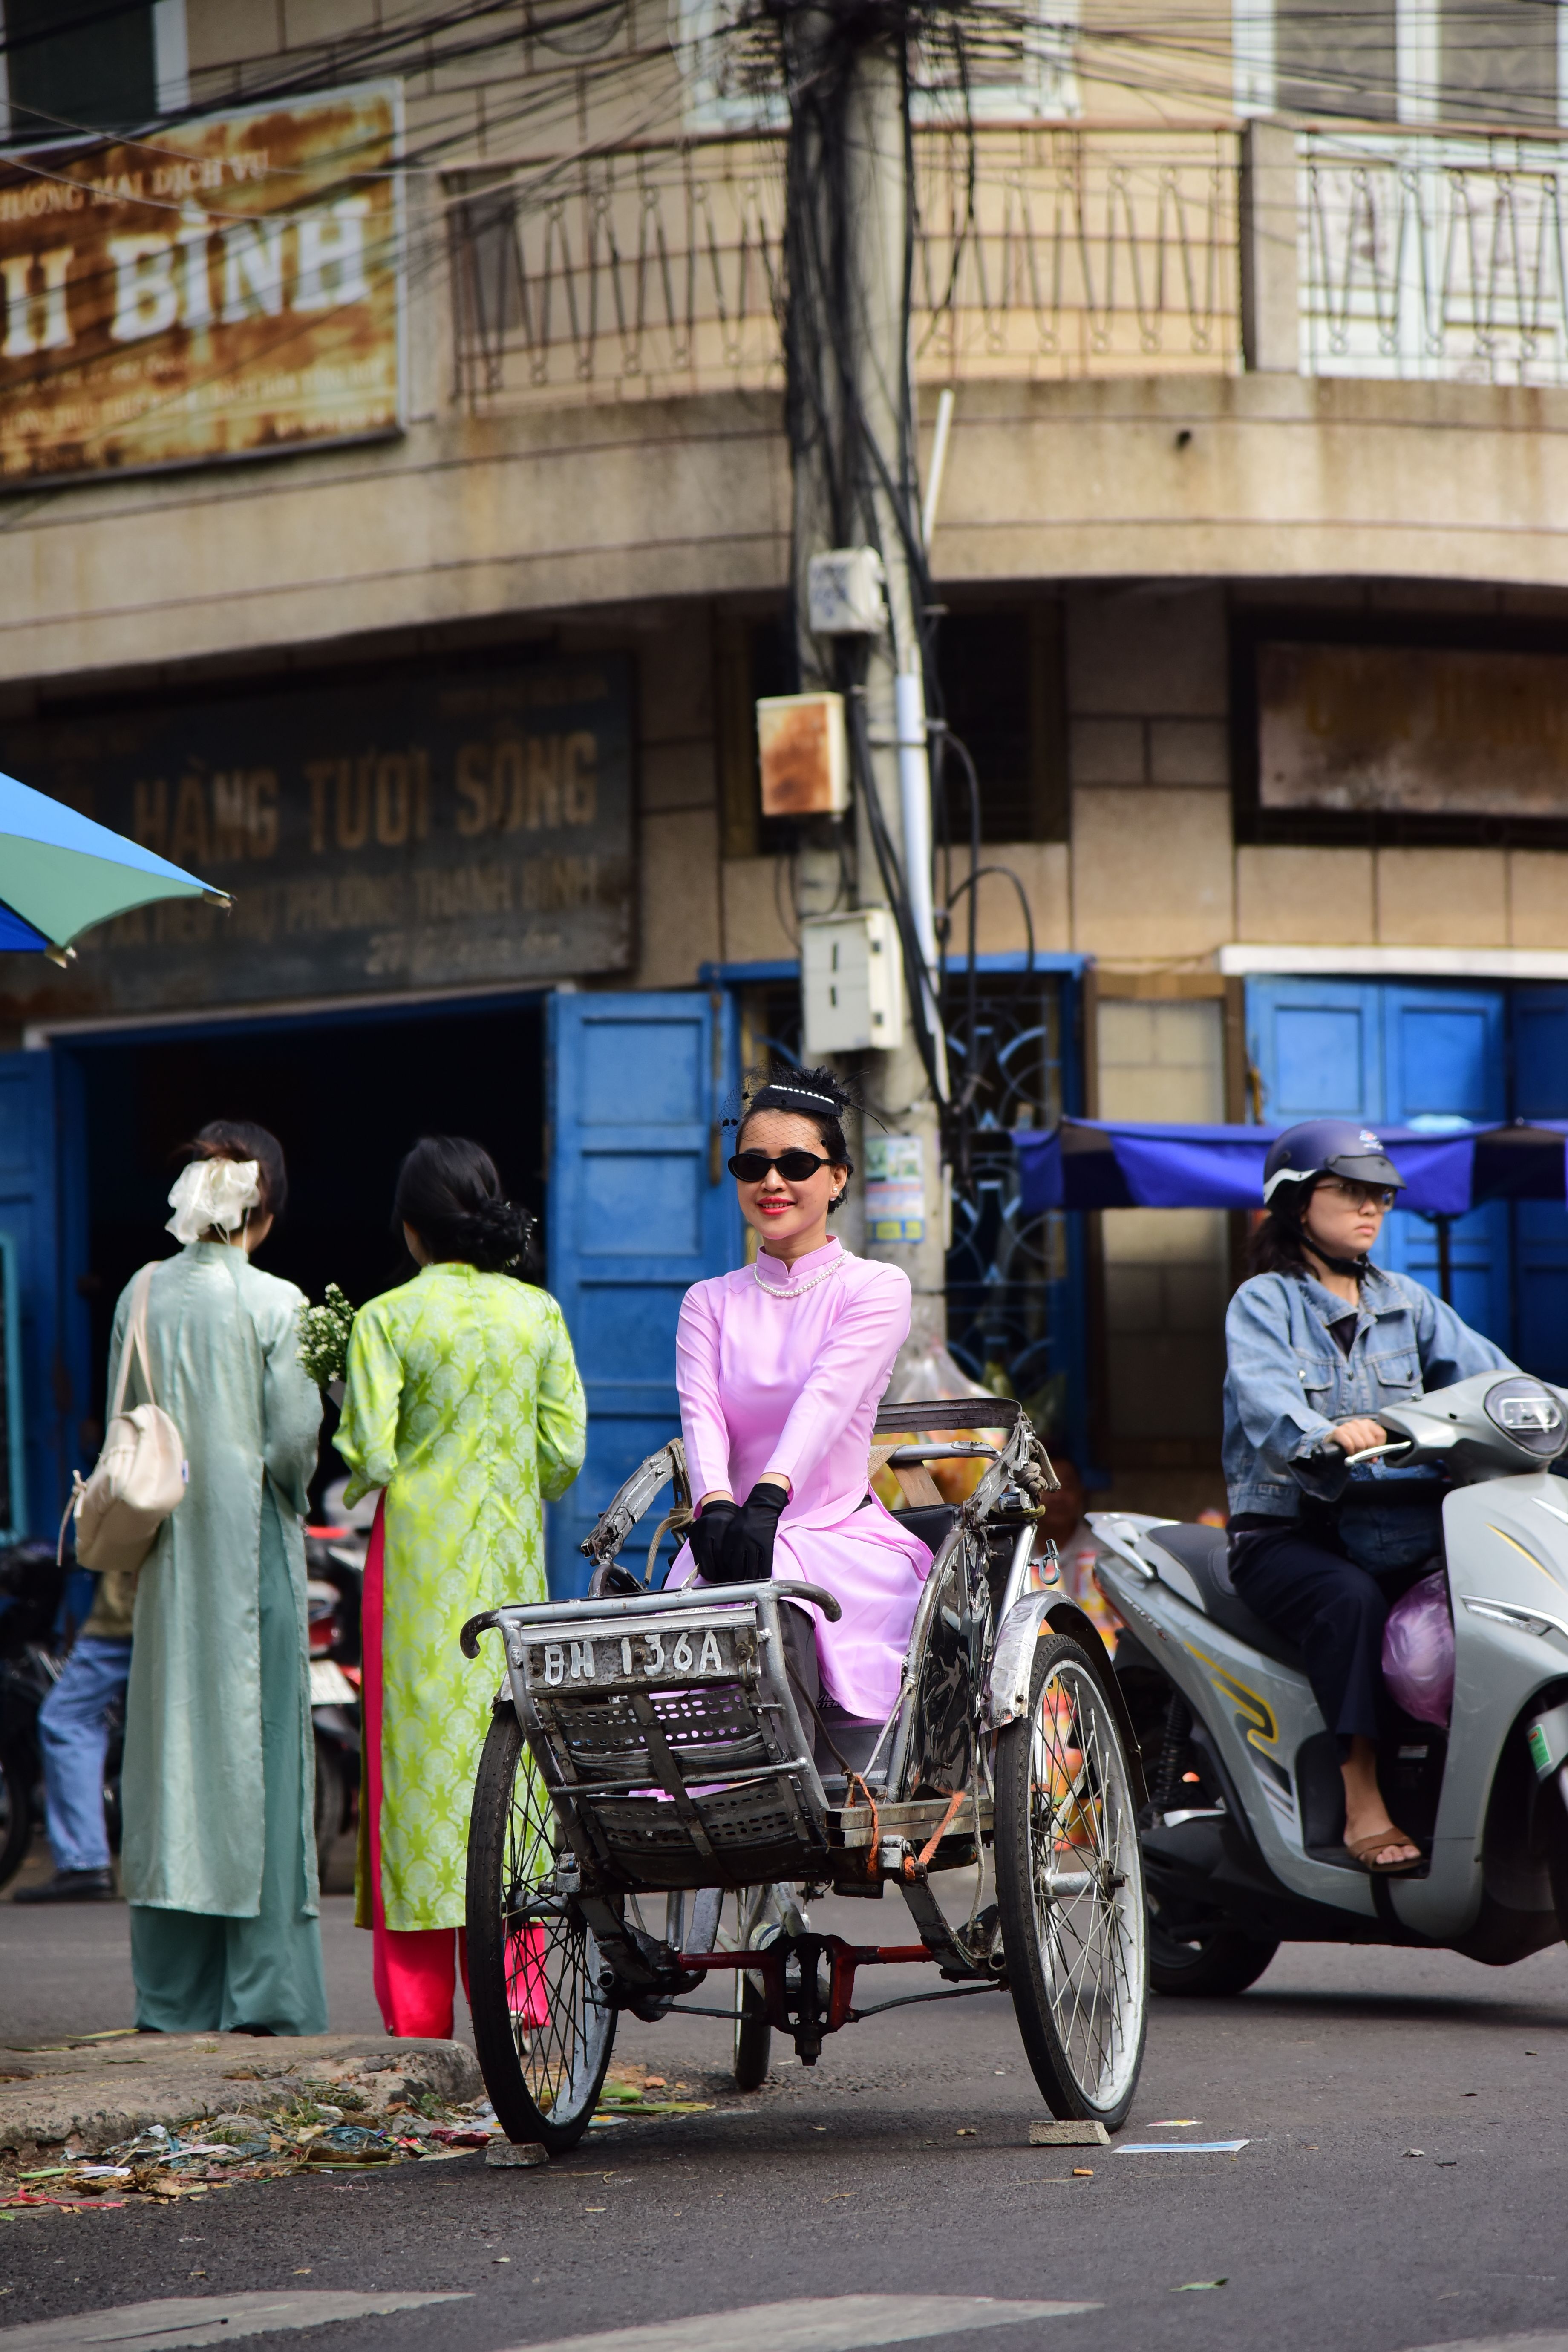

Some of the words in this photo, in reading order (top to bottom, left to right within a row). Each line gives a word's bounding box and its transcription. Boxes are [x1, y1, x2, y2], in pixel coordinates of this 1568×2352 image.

[109, 196, 372, 342] BÌNH
[544, 1640, 595, 1686] BH
[620, 1630, 722, 1677] 136A
